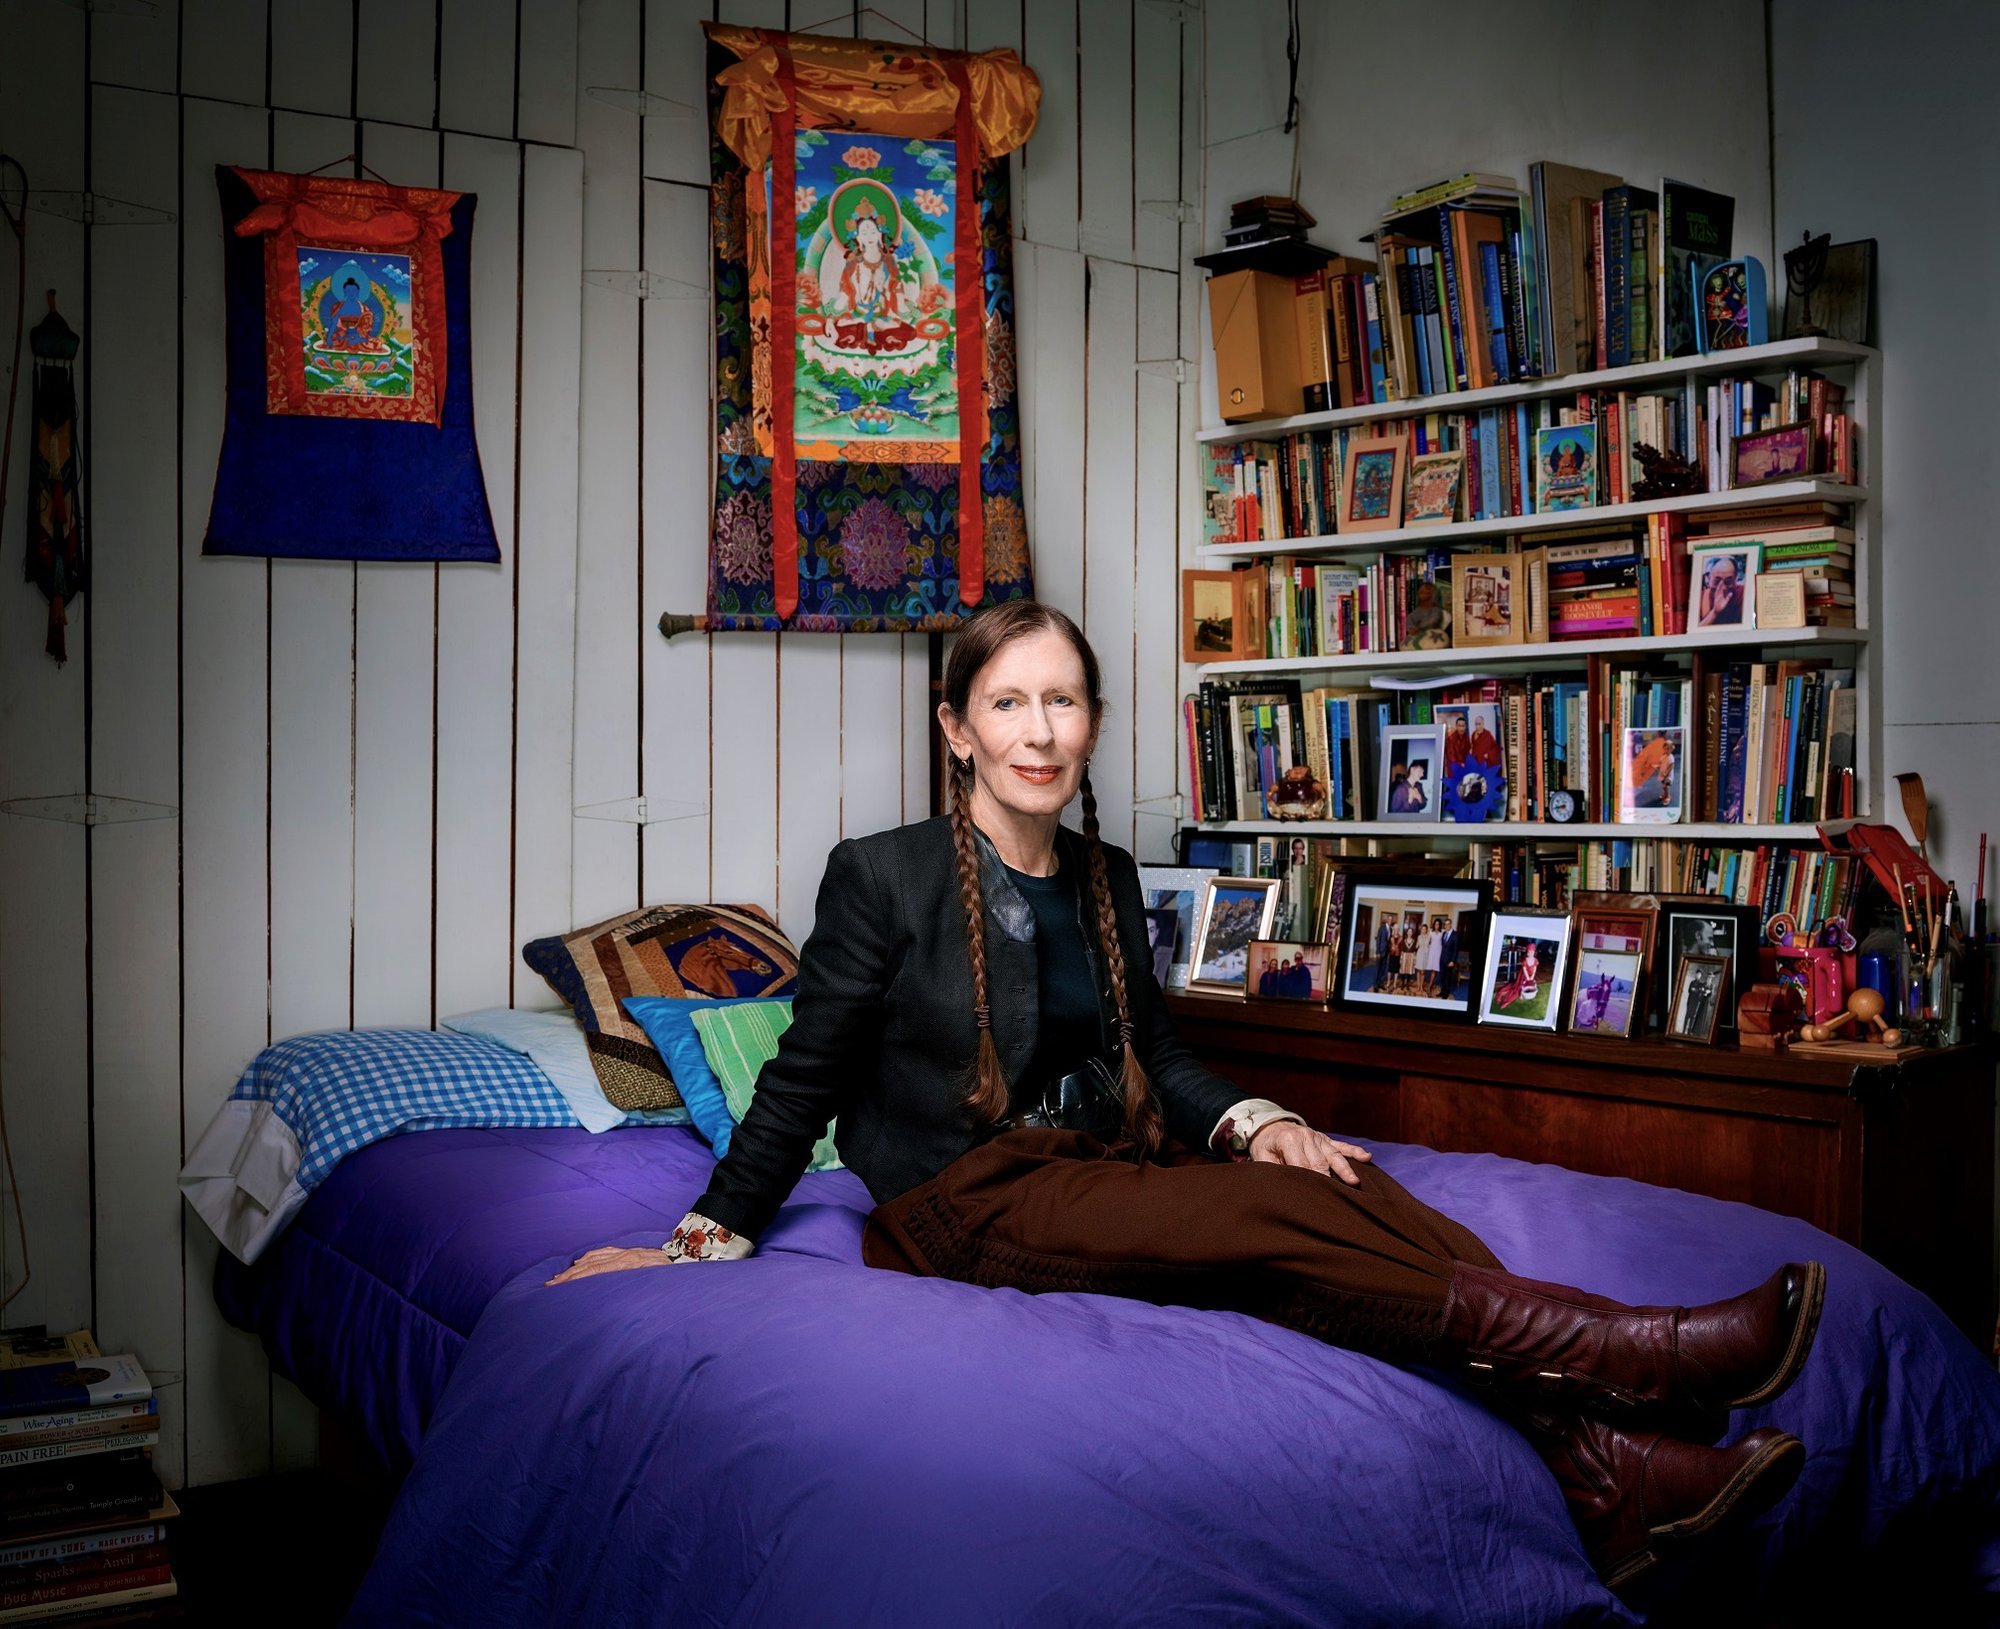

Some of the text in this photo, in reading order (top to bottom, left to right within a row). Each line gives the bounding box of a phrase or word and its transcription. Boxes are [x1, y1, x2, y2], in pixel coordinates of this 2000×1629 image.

[1592, 216, 1602, 244] Soldier
[1594, 245, 1602, 262] Life
[1440, 217, 1459, 325] LAND OF THE ICE KING
[1595, 264, 1603, 279] and
[1426, 269, 1437, 309] ARCANA
[1610, 224, 1625, 353] THE CIVIL WAR
[1596, 295, 1605, 320] Secret
[1514, 313, 1525, 359] WALKING
[1598, 322, 1606, 351] Service
[1563, 601, 1603, 613] ELEANOR
[1564, 609, 1614, 621] ROOSEVELT
[1315, 705, 1325, 741] Language
[1719, 686, 1729, 767] winter music
[1510, 704, 1519, 798] TESTAMENT ELIE WIESEL
[1491, 846, 1502, 873] THE
[23, 1416, 74, 1430] Wise Aging
[39, 1430, 67, 1439] POWER
[74, 1426, 100, 1434] SOUND
[0, 1445, 64, 1464] PAIN FREE
[89, 1495, 143, 1510] Temple Grandin
[40, 1549, 50, 1557] OF
[61, 1541, 87, 1554] SONG
[98, 1534, 145, 1548] MARC MYERS
[34, 1565, 75, 1584] Sparks
[102, 1553, 136, 1569] Anvil
